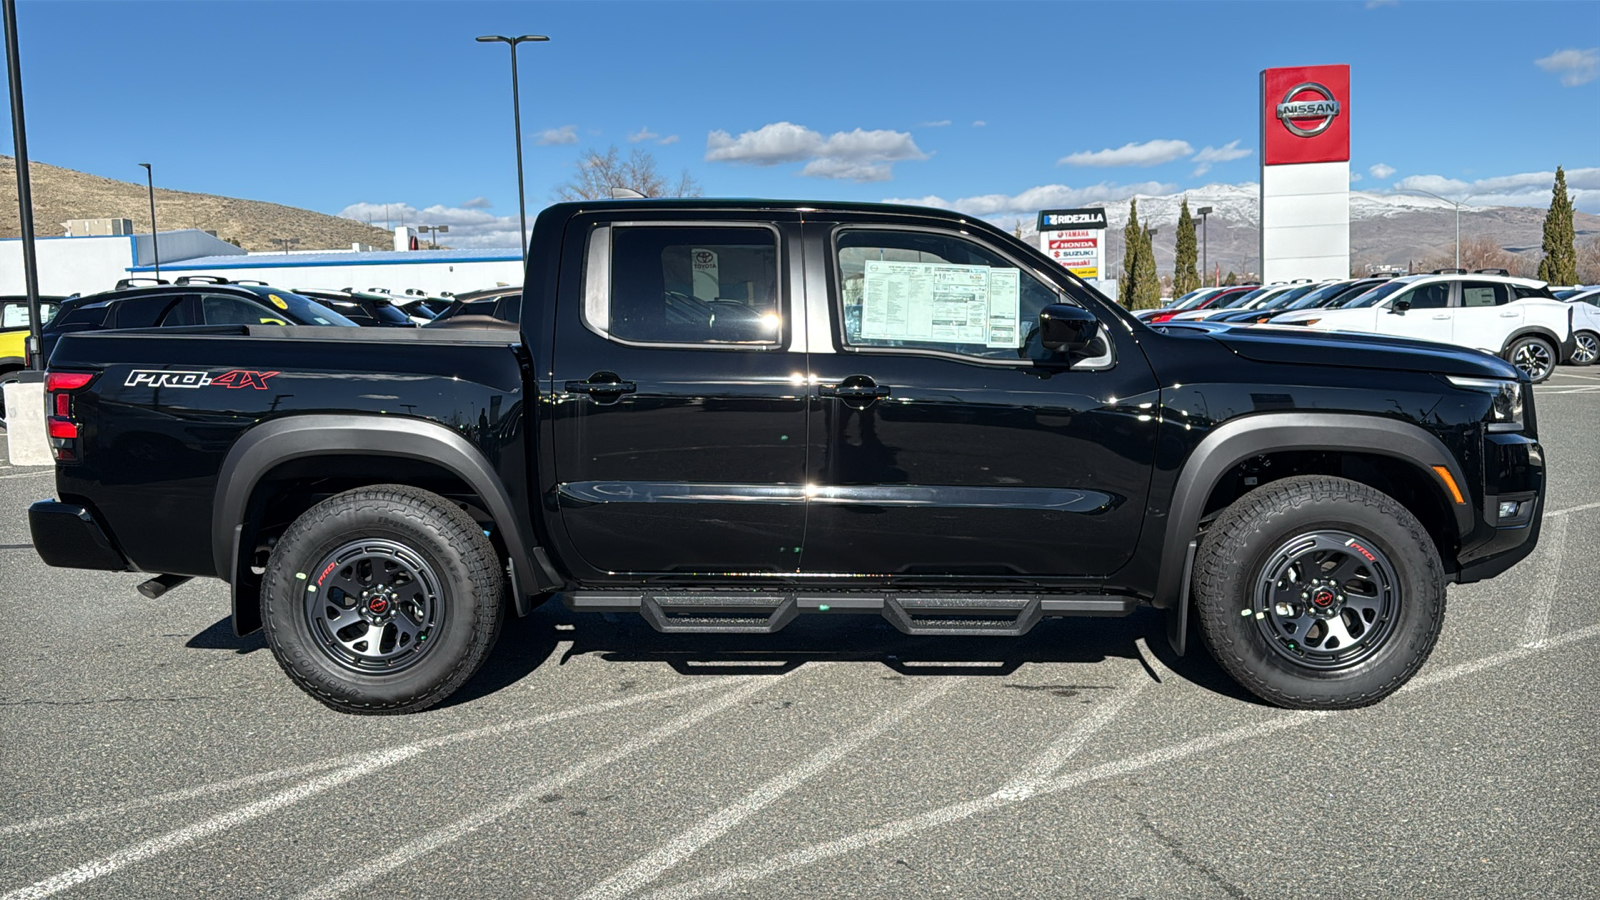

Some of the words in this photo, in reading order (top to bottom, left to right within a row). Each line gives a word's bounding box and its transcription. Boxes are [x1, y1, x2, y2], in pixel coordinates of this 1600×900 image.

[1283, 103, 1335, 114] NISSAN
[1058, 213, 1104, 224] RIDEZILLA
[1350, 542, 1376, 562] PRO
[317, 561, 336, 587] PRO
